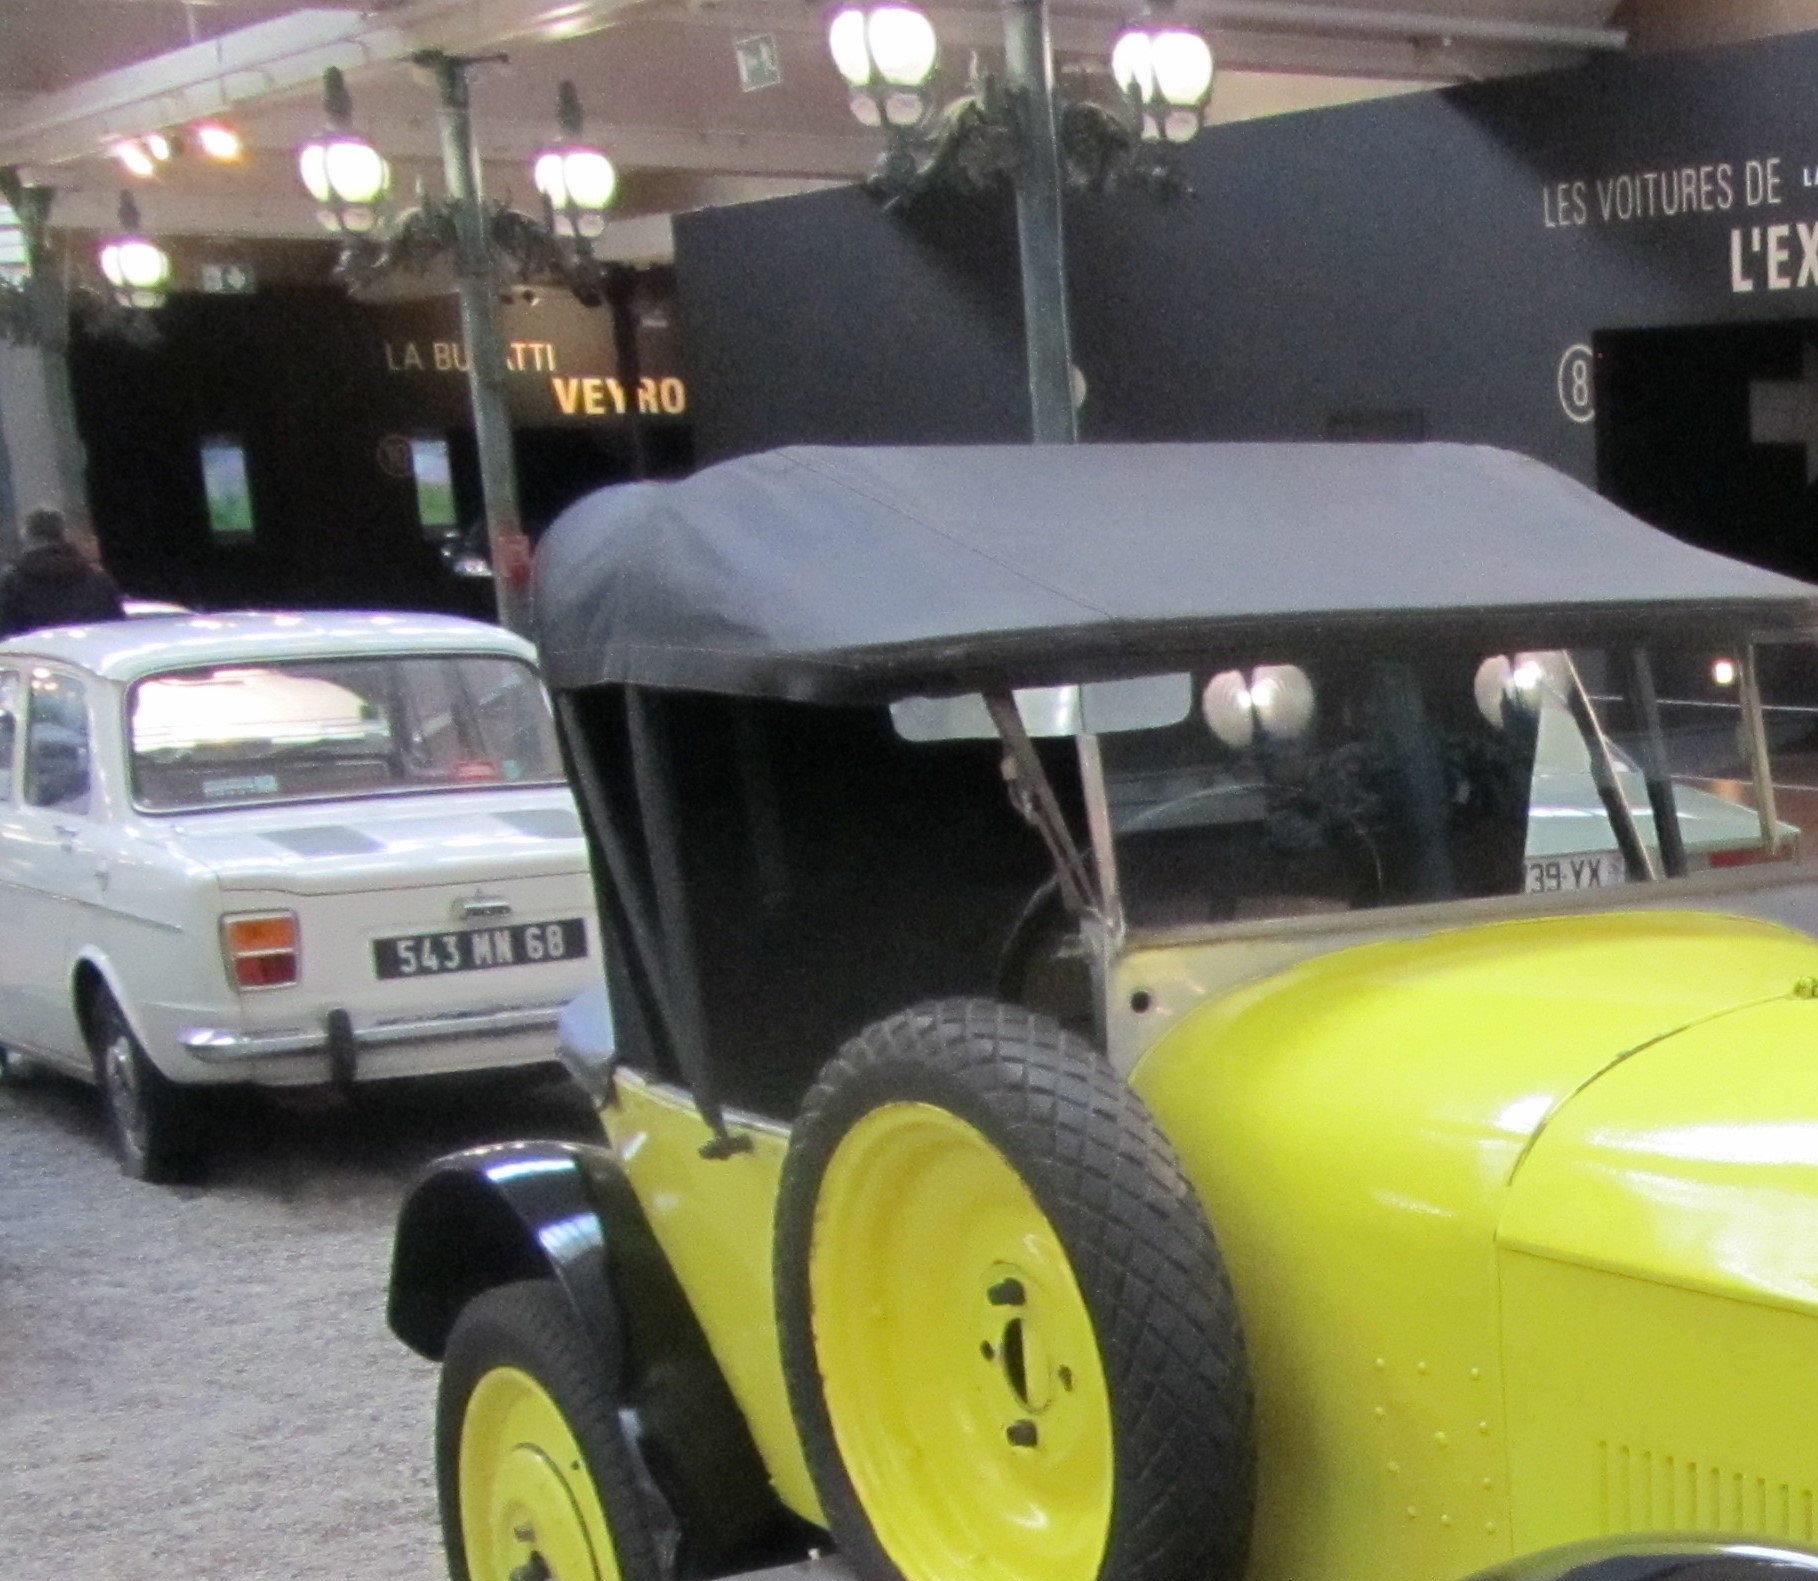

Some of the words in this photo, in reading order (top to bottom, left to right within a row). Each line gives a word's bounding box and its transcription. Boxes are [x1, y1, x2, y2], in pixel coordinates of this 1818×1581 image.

[1543, 181, 1586, 227] LES
[1597, 163, 1733, 221] VOITURES
[1745, 157, 1782, 206] DE
[384, 342, 423, 371] LA
[432, 341, 556, 371] BUTTI
[1572, 360, 1588, 406] 8
[396, 935, 461, 974] 543
[524, 924, 565, 960] 68
